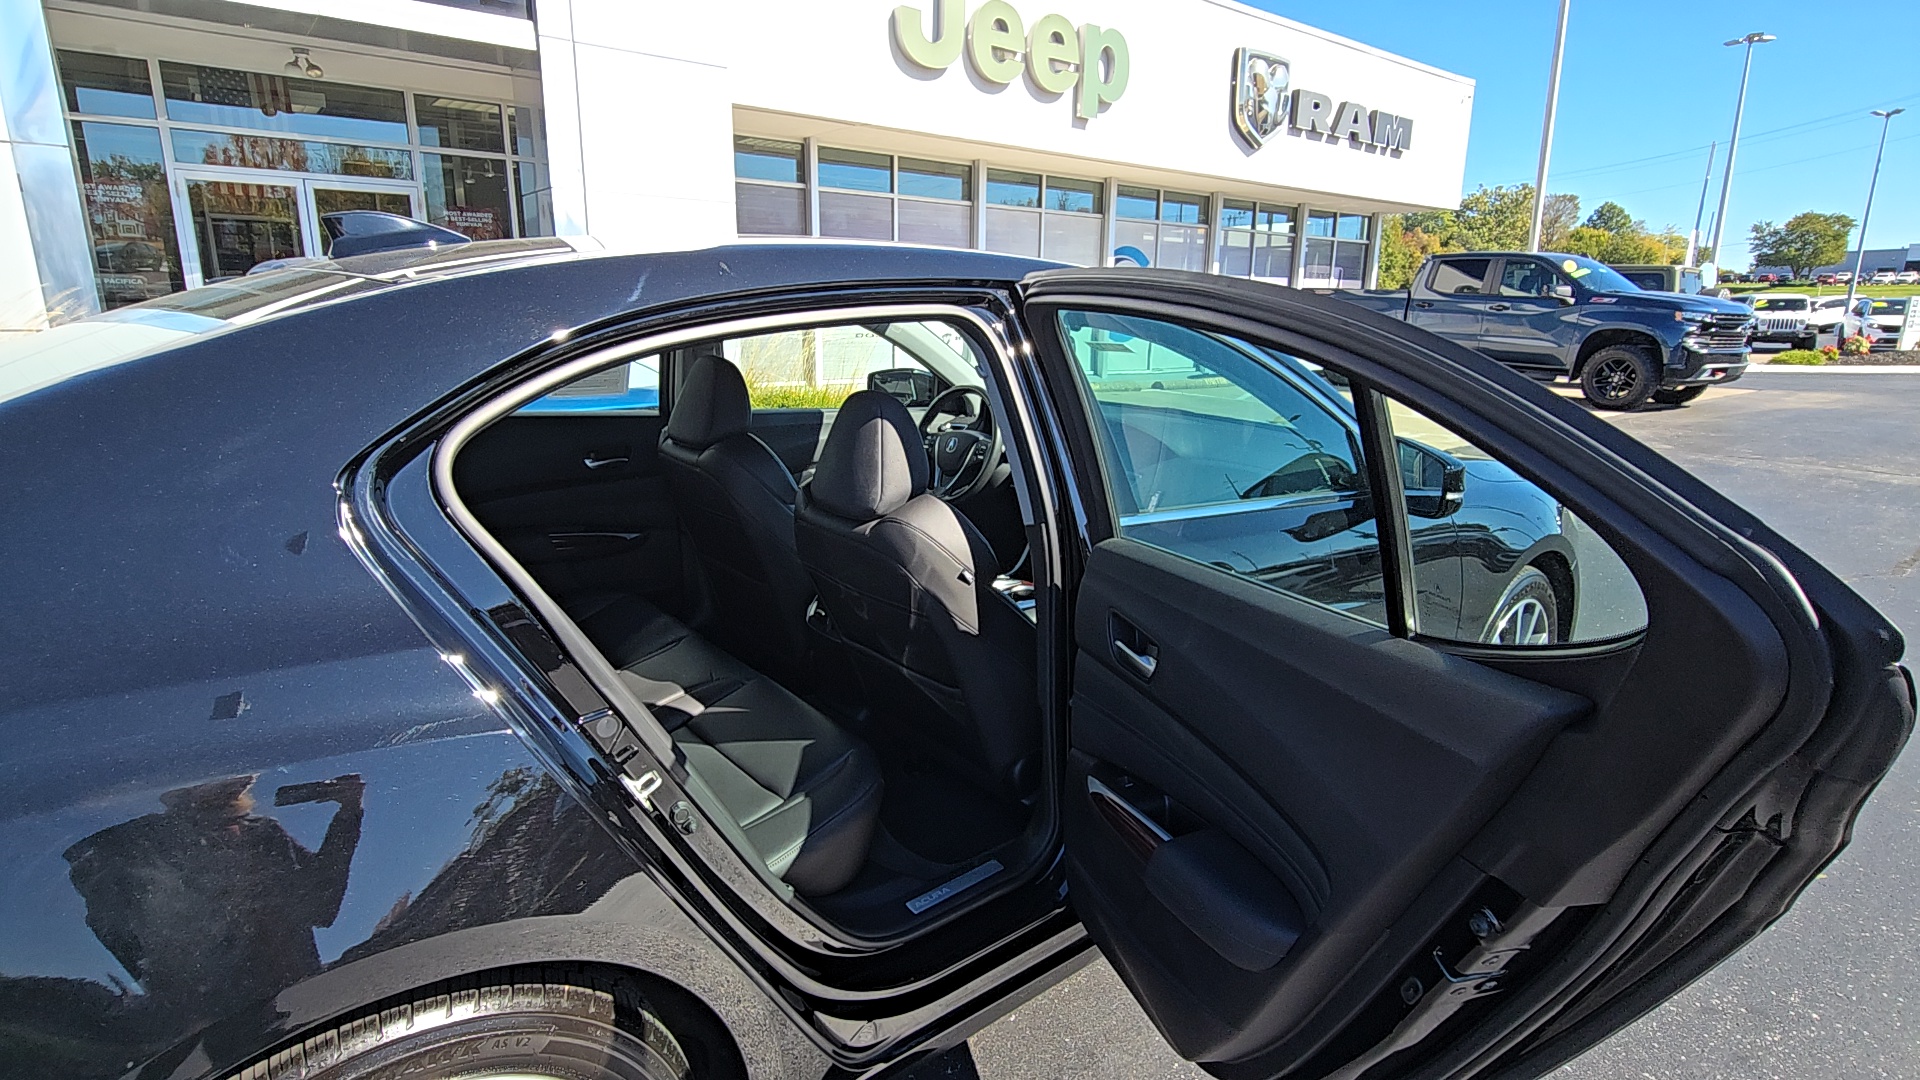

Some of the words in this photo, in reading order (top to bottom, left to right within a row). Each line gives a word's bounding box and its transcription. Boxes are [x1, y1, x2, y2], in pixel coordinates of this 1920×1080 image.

[892, 0, 1130, 118] Jeep
[1290, 88, 1414, 151] RAM
[86, 189, 143, 199] EST-SELLING
[98, 184, 143, 193] AWARDED
[103, 277, 144, 285] PACIFICA
[915, 888, 950, 907] ACURA
[491, 1041, 509, 1051] AS
[515, 1037, 532, 1048] V2
